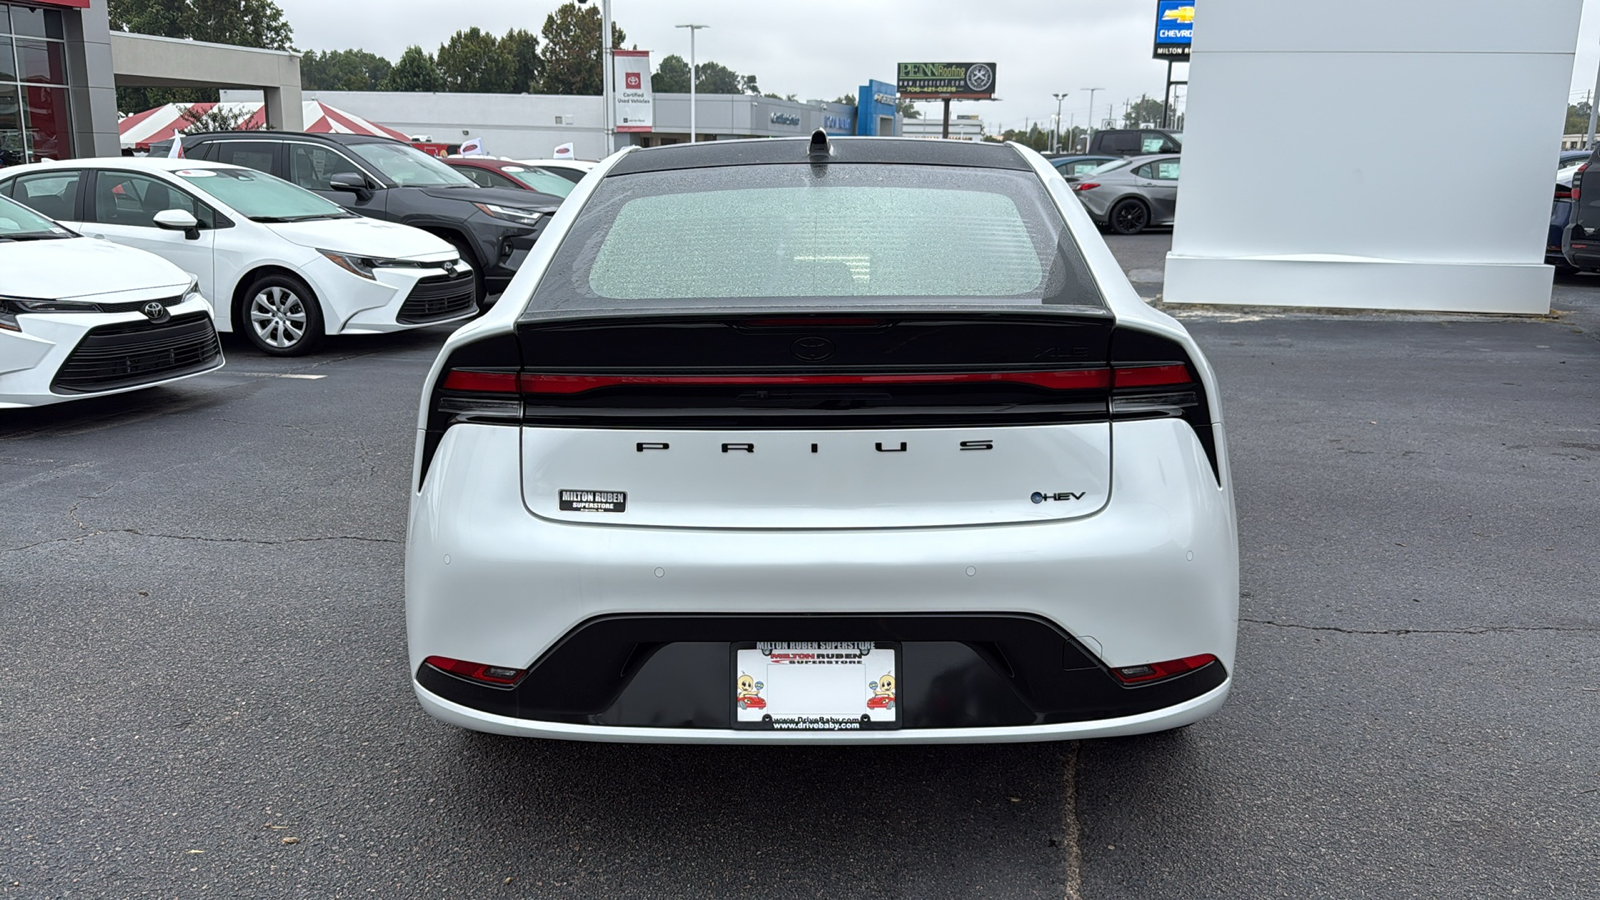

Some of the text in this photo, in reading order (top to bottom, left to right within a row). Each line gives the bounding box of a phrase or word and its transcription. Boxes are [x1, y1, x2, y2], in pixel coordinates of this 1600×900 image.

[899, 63, 965, 78] PENN Roofing
[1035, 347, 1089, 358] XLE
[636, 440, 993, 453] PRIUS
[562, 491, 624, 503] MILTON RUBEN
[1043, 491, 1086, 502] HEV
[756, 642, 876, 650] MILTON RUBEN SUPERSTORE
[773, 721, 860, 730] www.drivebaby.com
